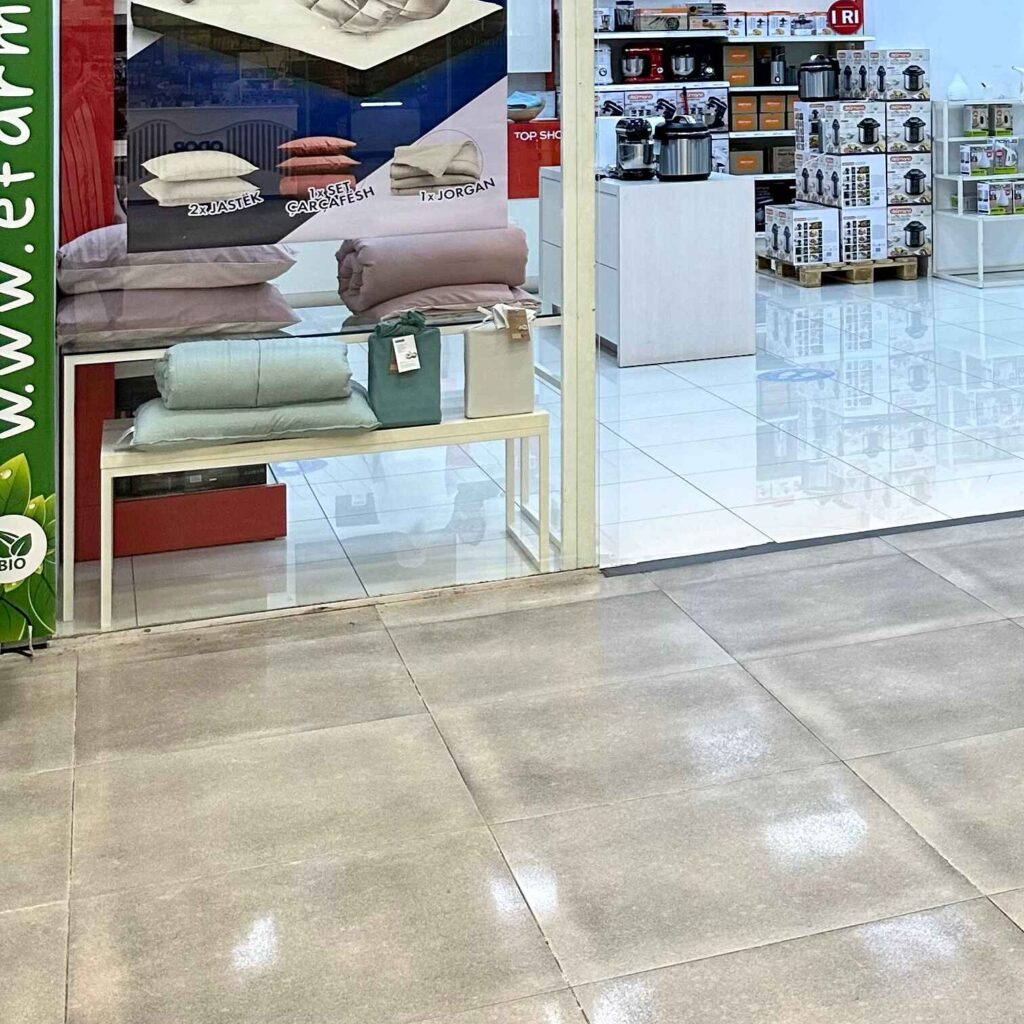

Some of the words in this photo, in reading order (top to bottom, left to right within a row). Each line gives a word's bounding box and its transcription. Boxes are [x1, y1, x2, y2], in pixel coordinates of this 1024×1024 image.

[513, 131, 538, 141] TOP
[286, 186, 376, 217] ÇARÇAFESH
[327, 181, 351, 197] SET
[421, 191, 434, 202] 1x
[438, 177, 496, 202] JORGAN
[188, 203, 209, 216] 2x
[210, 190, 264, 214] JASTËK
